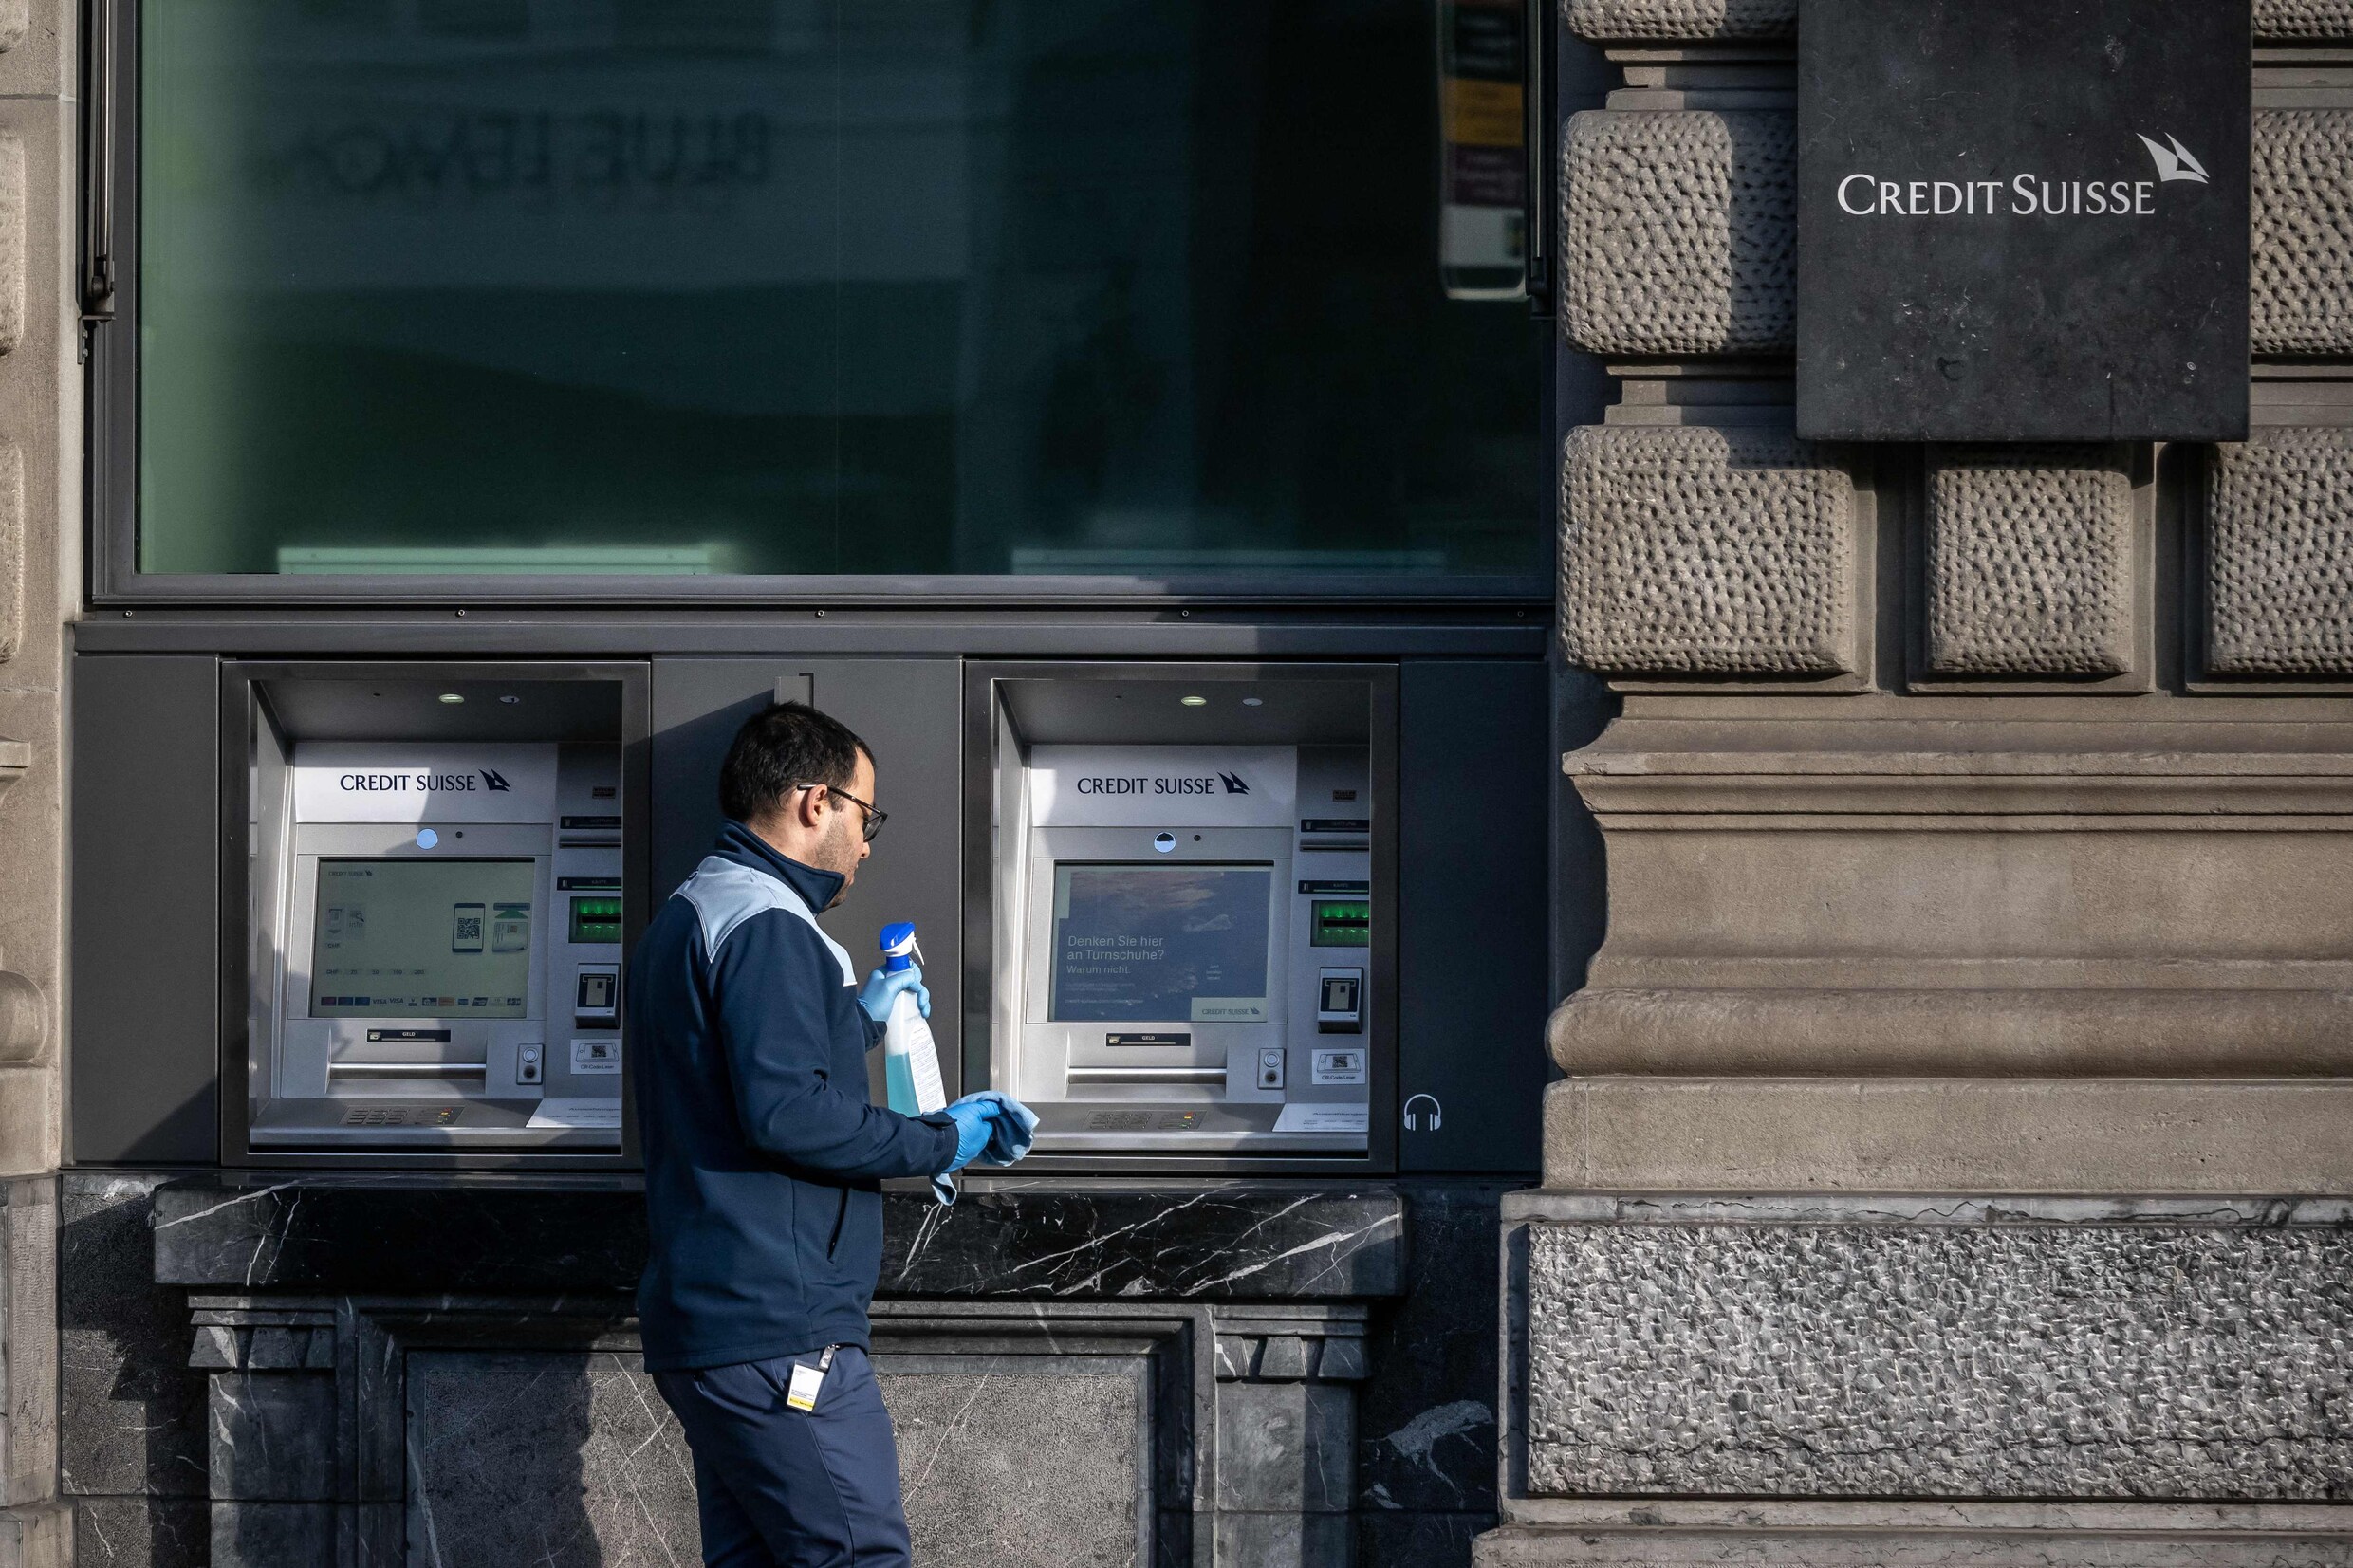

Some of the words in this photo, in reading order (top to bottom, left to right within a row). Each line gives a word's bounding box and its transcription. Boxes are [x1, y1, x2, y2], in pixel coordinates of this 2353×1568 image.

[1837, 173, 2004, 215] CREDIT
[2011, 173, 2156, 215] SUISSE
[340, 774, 411, 791] CREDIT
[416, 774, 476, 791] SUISSE
[1077, 777, 1149, 794] CREDIT
[1154, 777, 1215, 794] SUISSE
[1068, 935, 1115, 947] Denken
[1118, 935, 1137, 947] Sie
[1140, 935, 1163, 947] hier
[1066, 951, 1083, 960] an
[1085, 950, 1164, 960] Turnschuhe?
[1066, 965, 1101, 974] Warum
[1103, 965, 1131, 974] nicht.
